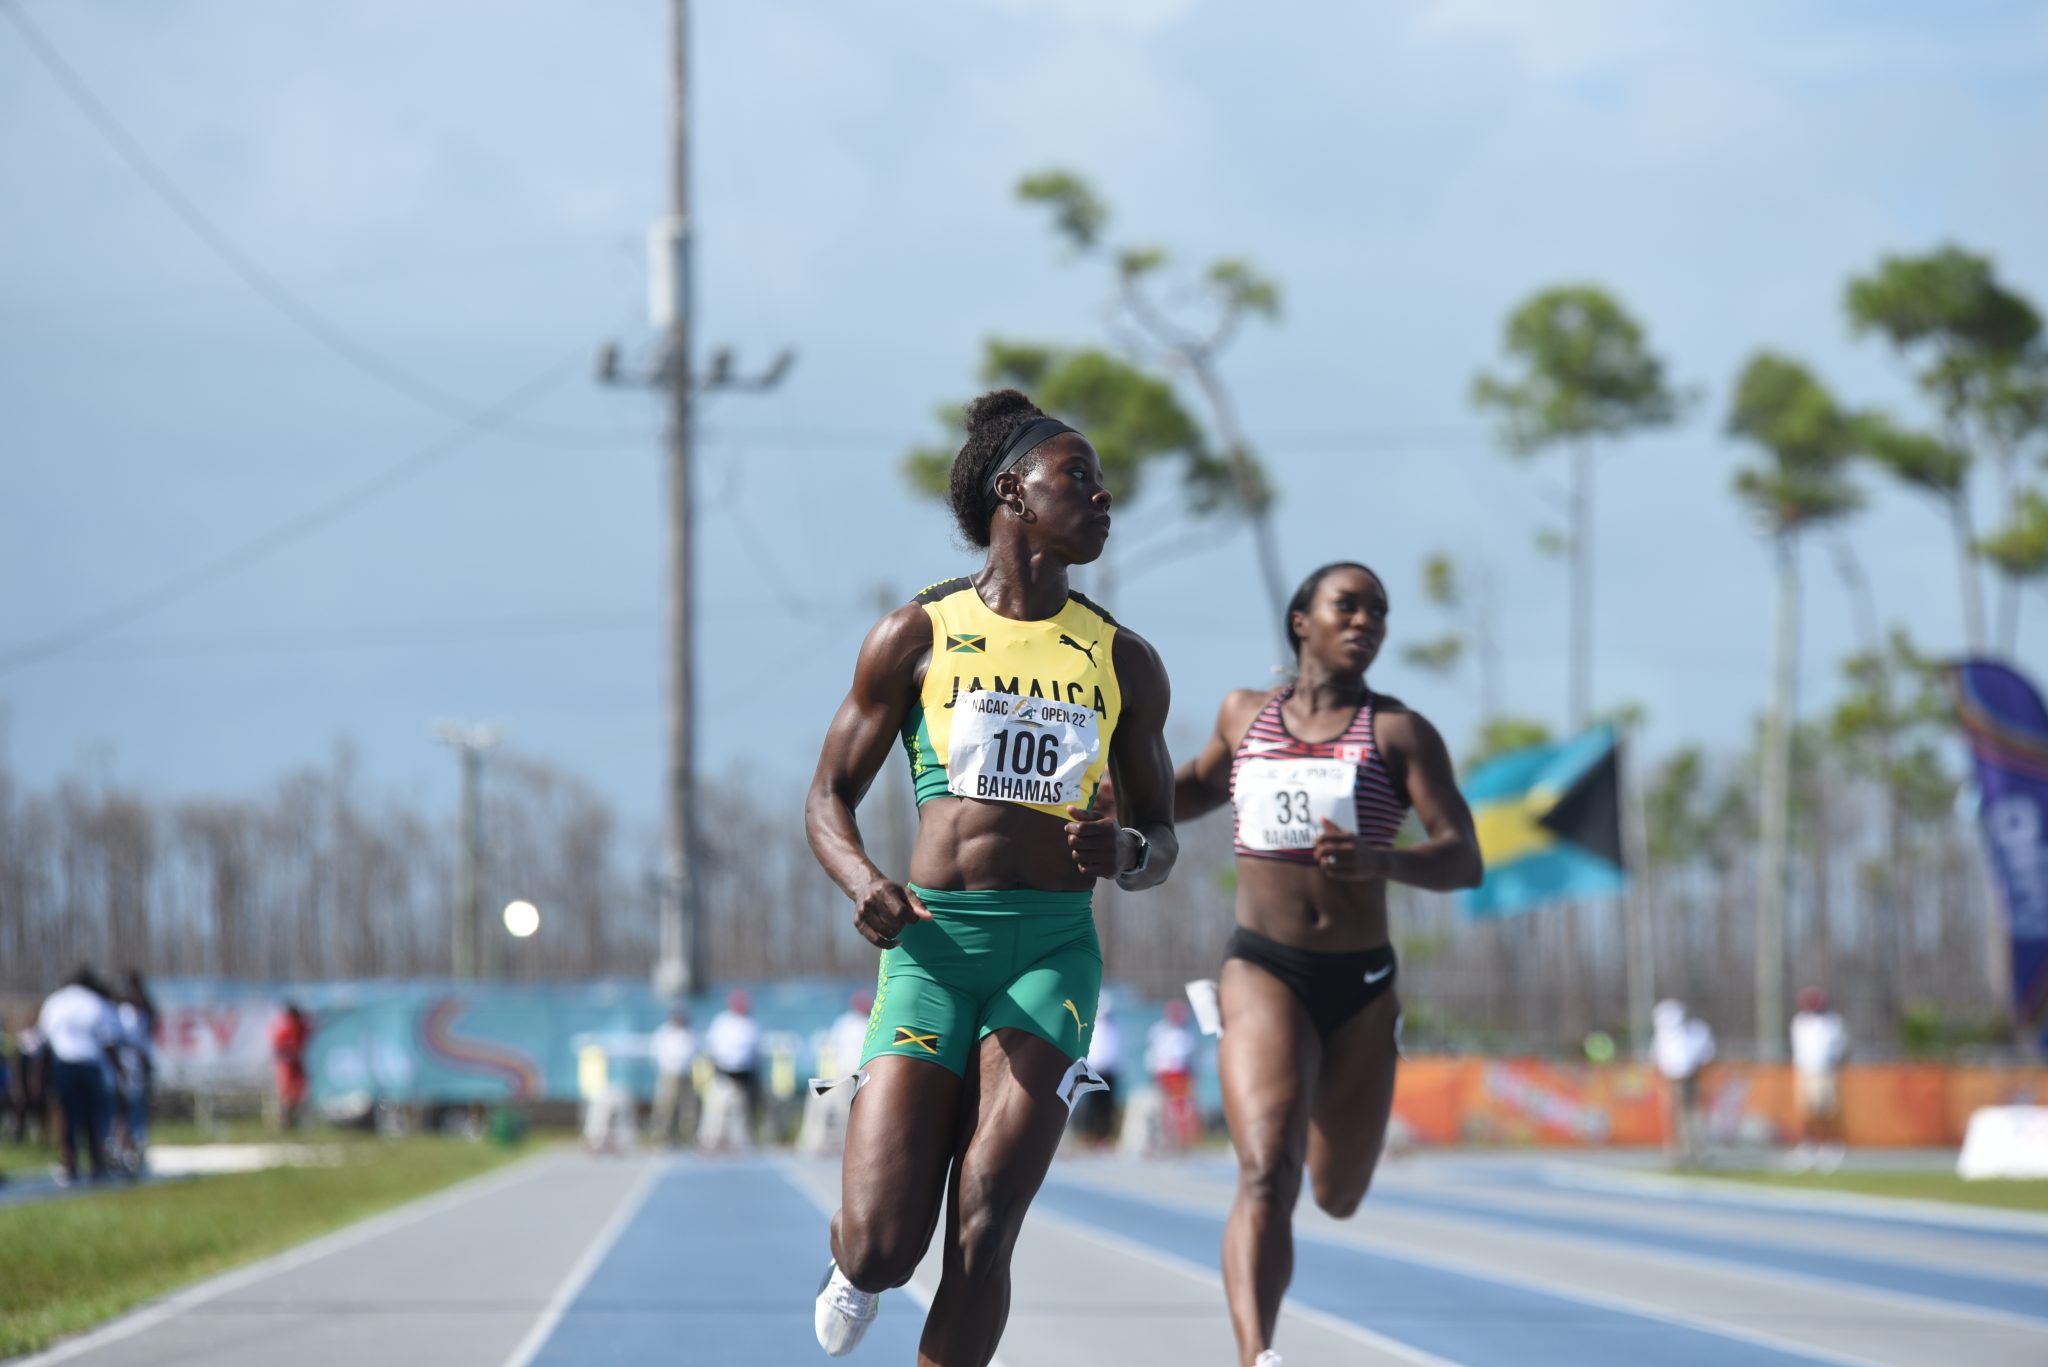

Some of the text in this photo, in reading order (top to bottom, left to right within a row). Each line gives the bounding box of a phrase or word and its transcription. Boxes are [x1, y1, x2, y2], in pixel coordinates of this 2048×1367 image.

[972, 699, 1087, 728] NACAC OPEN 22
[993, 729, 1059, 777] 106
[976, 774, 1063, 803] BAHAMAS
[1276, 790, 1310, 825] 33
